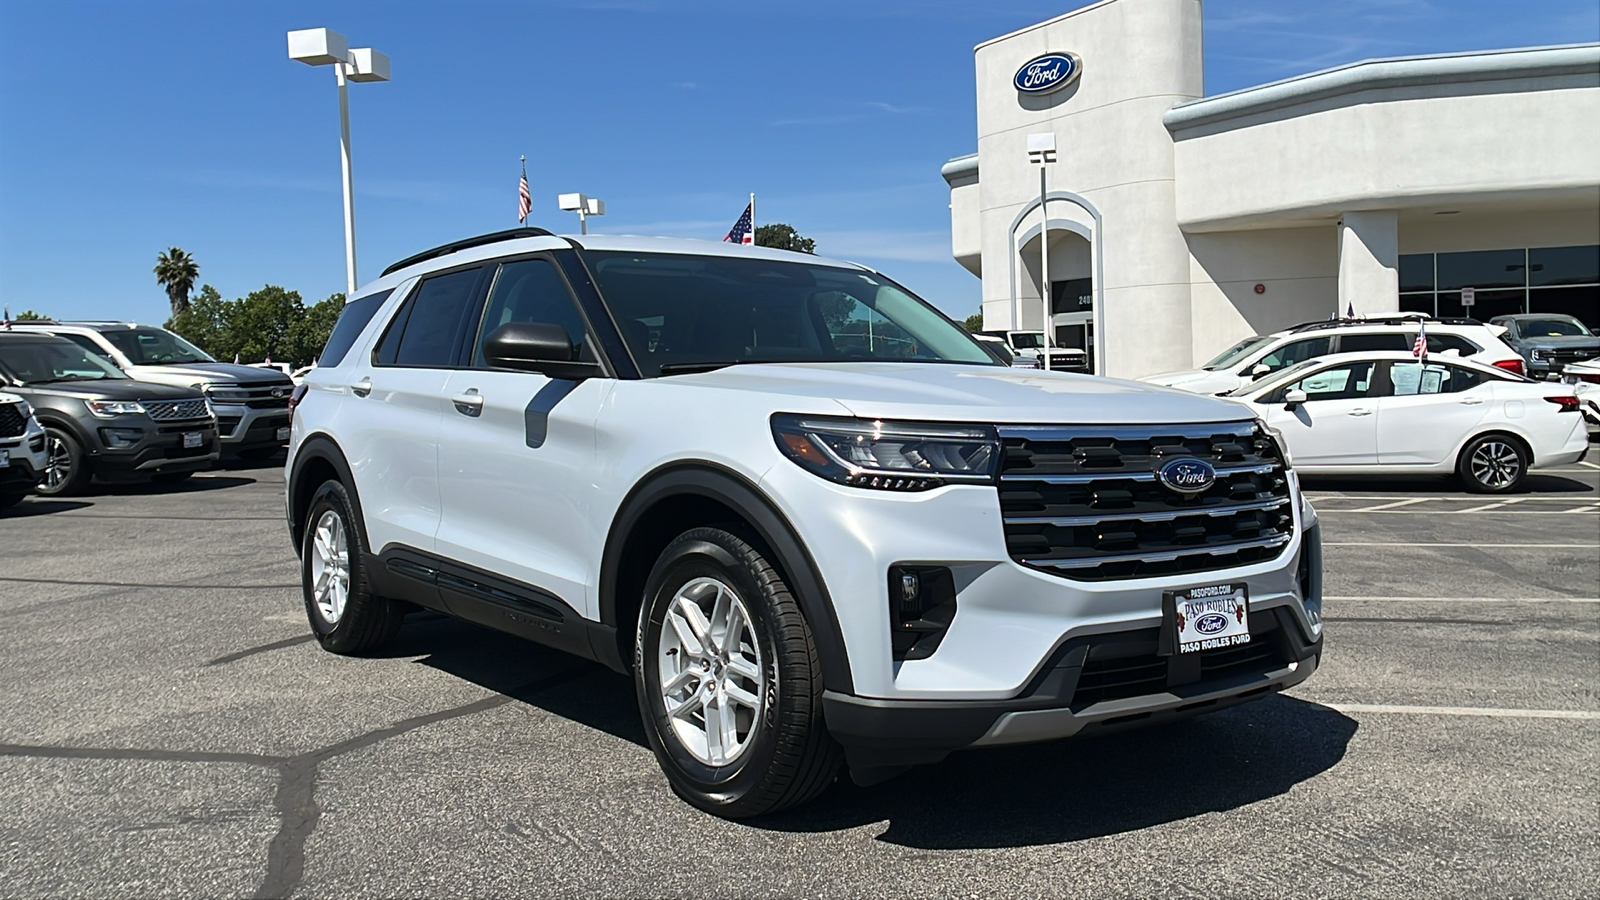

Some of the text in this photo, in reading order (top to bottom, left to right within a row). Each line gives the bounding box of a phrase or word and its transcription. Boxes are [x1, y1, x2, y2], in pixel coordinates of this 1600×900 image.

[1024, 60, 1061, 87] Ford
[1176, 465, 1206, 485] Ford
[1190, 585, 1231, 598] PASOFORD.COM
[1185, 597, 1237, 621] PASO ROBLES
[1201, 616, 1223, 632] Ford
[1180, 633, 1251, 653] PASO ROBLES FORD
